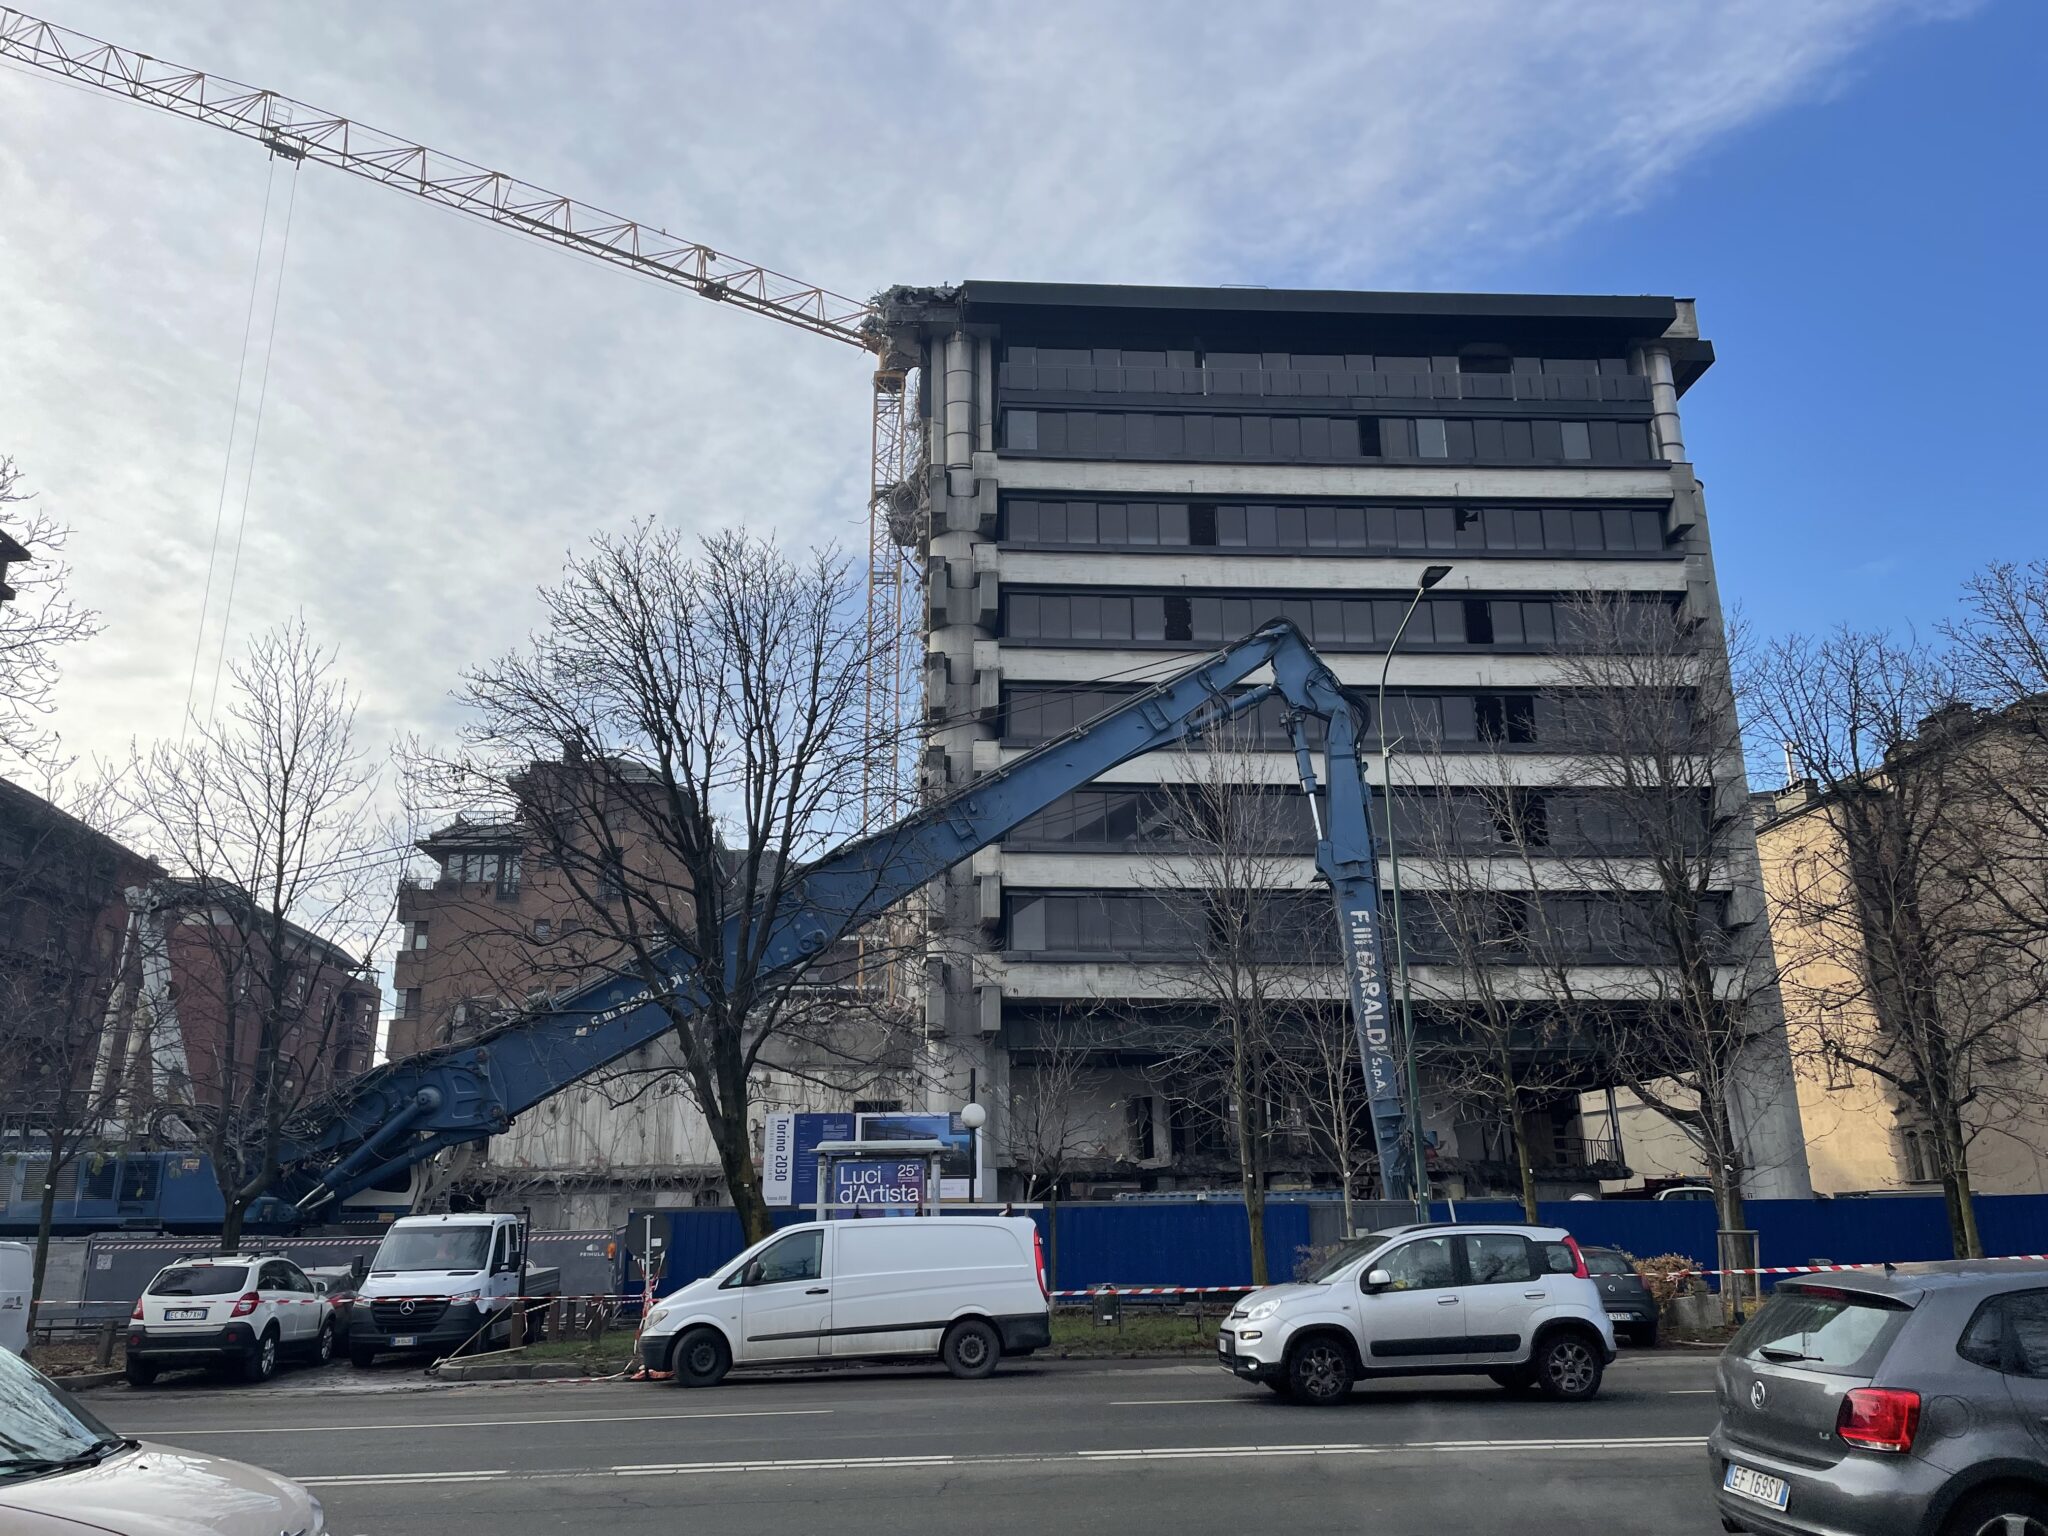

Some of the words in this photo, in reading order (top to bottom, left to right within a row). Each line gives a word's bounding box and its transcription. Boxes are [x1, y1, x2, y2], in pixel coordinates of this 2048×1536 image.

[1356, 951, 1388, 1052] BARALDI
[776, 1118, 789, 1152] Torino
[775, 1155, 788, 1182] 2030
[840, 1165, 881, 1185] Luci
[840, 1183, 920, 1204] d'Artista
[1732, 1467, 1748, 1488] EF
[1749, 1473, 1783, 1501] 169SV
